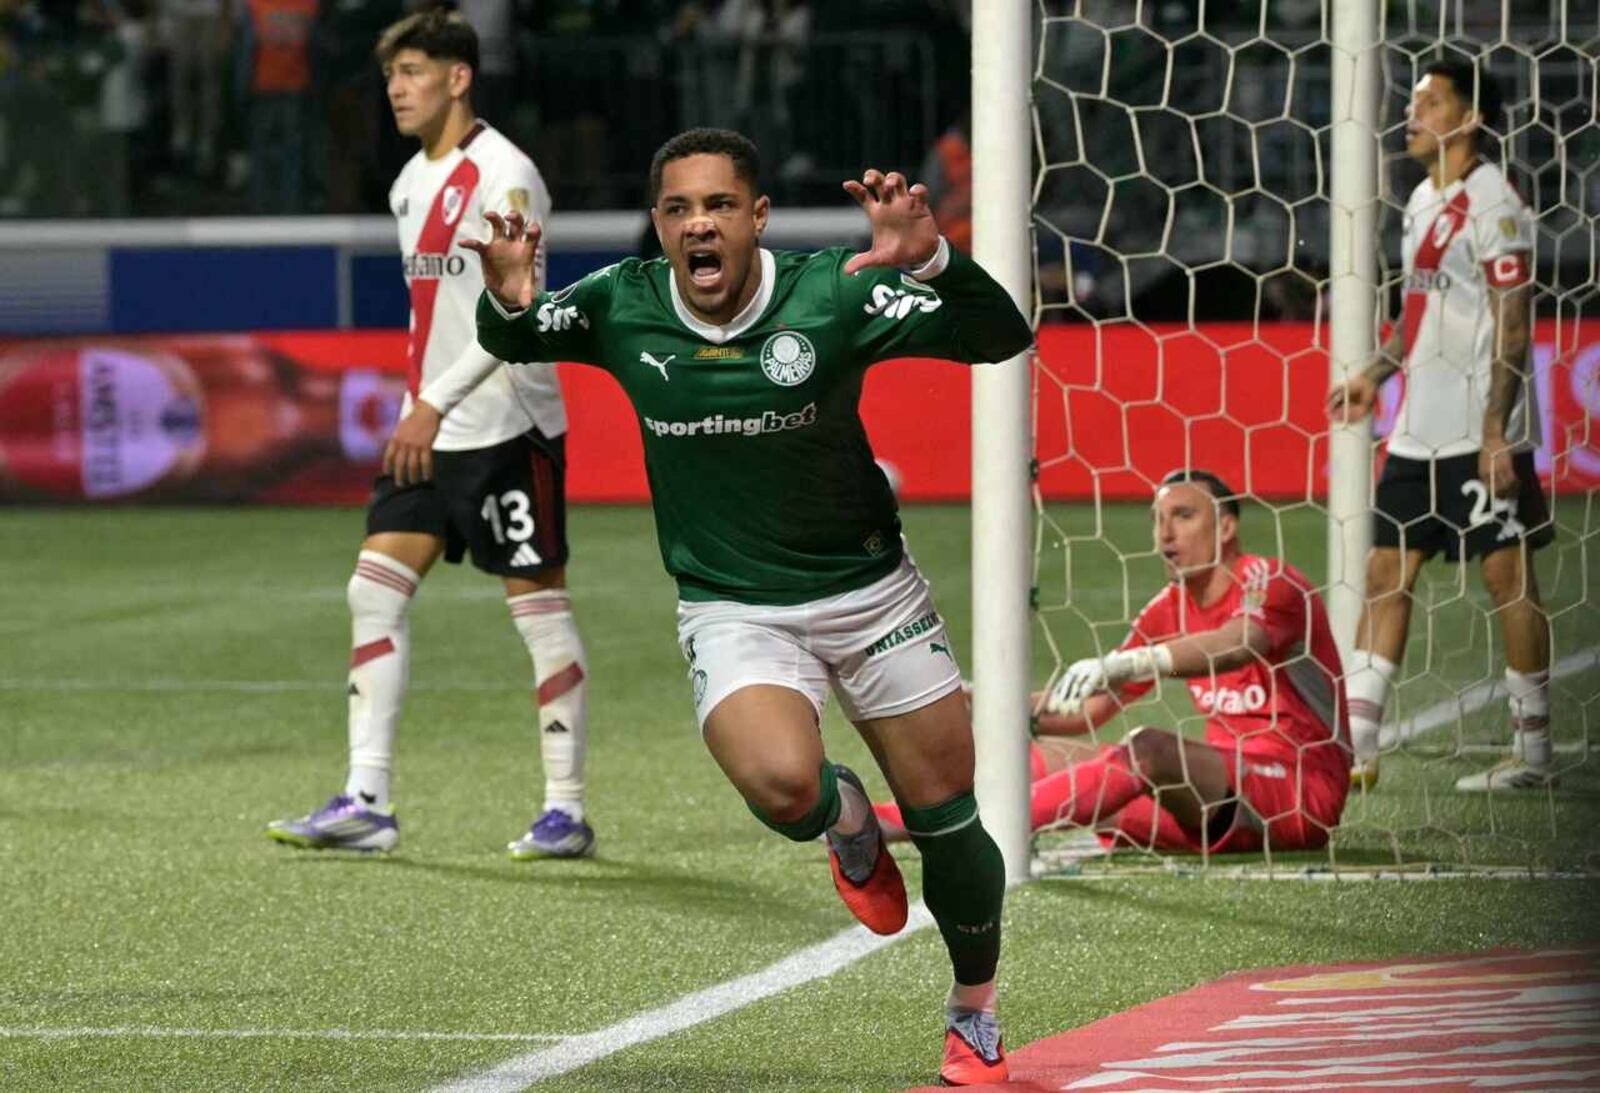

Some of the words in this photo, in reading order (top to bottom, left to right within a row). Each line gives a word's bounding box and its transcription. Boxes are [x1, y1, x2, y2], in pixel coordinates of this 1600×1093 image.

[1494, 255, 1519, 281] C
[764, 351, 812, 383] PALMEIRAS
[481, 489, 535, 545] 13
